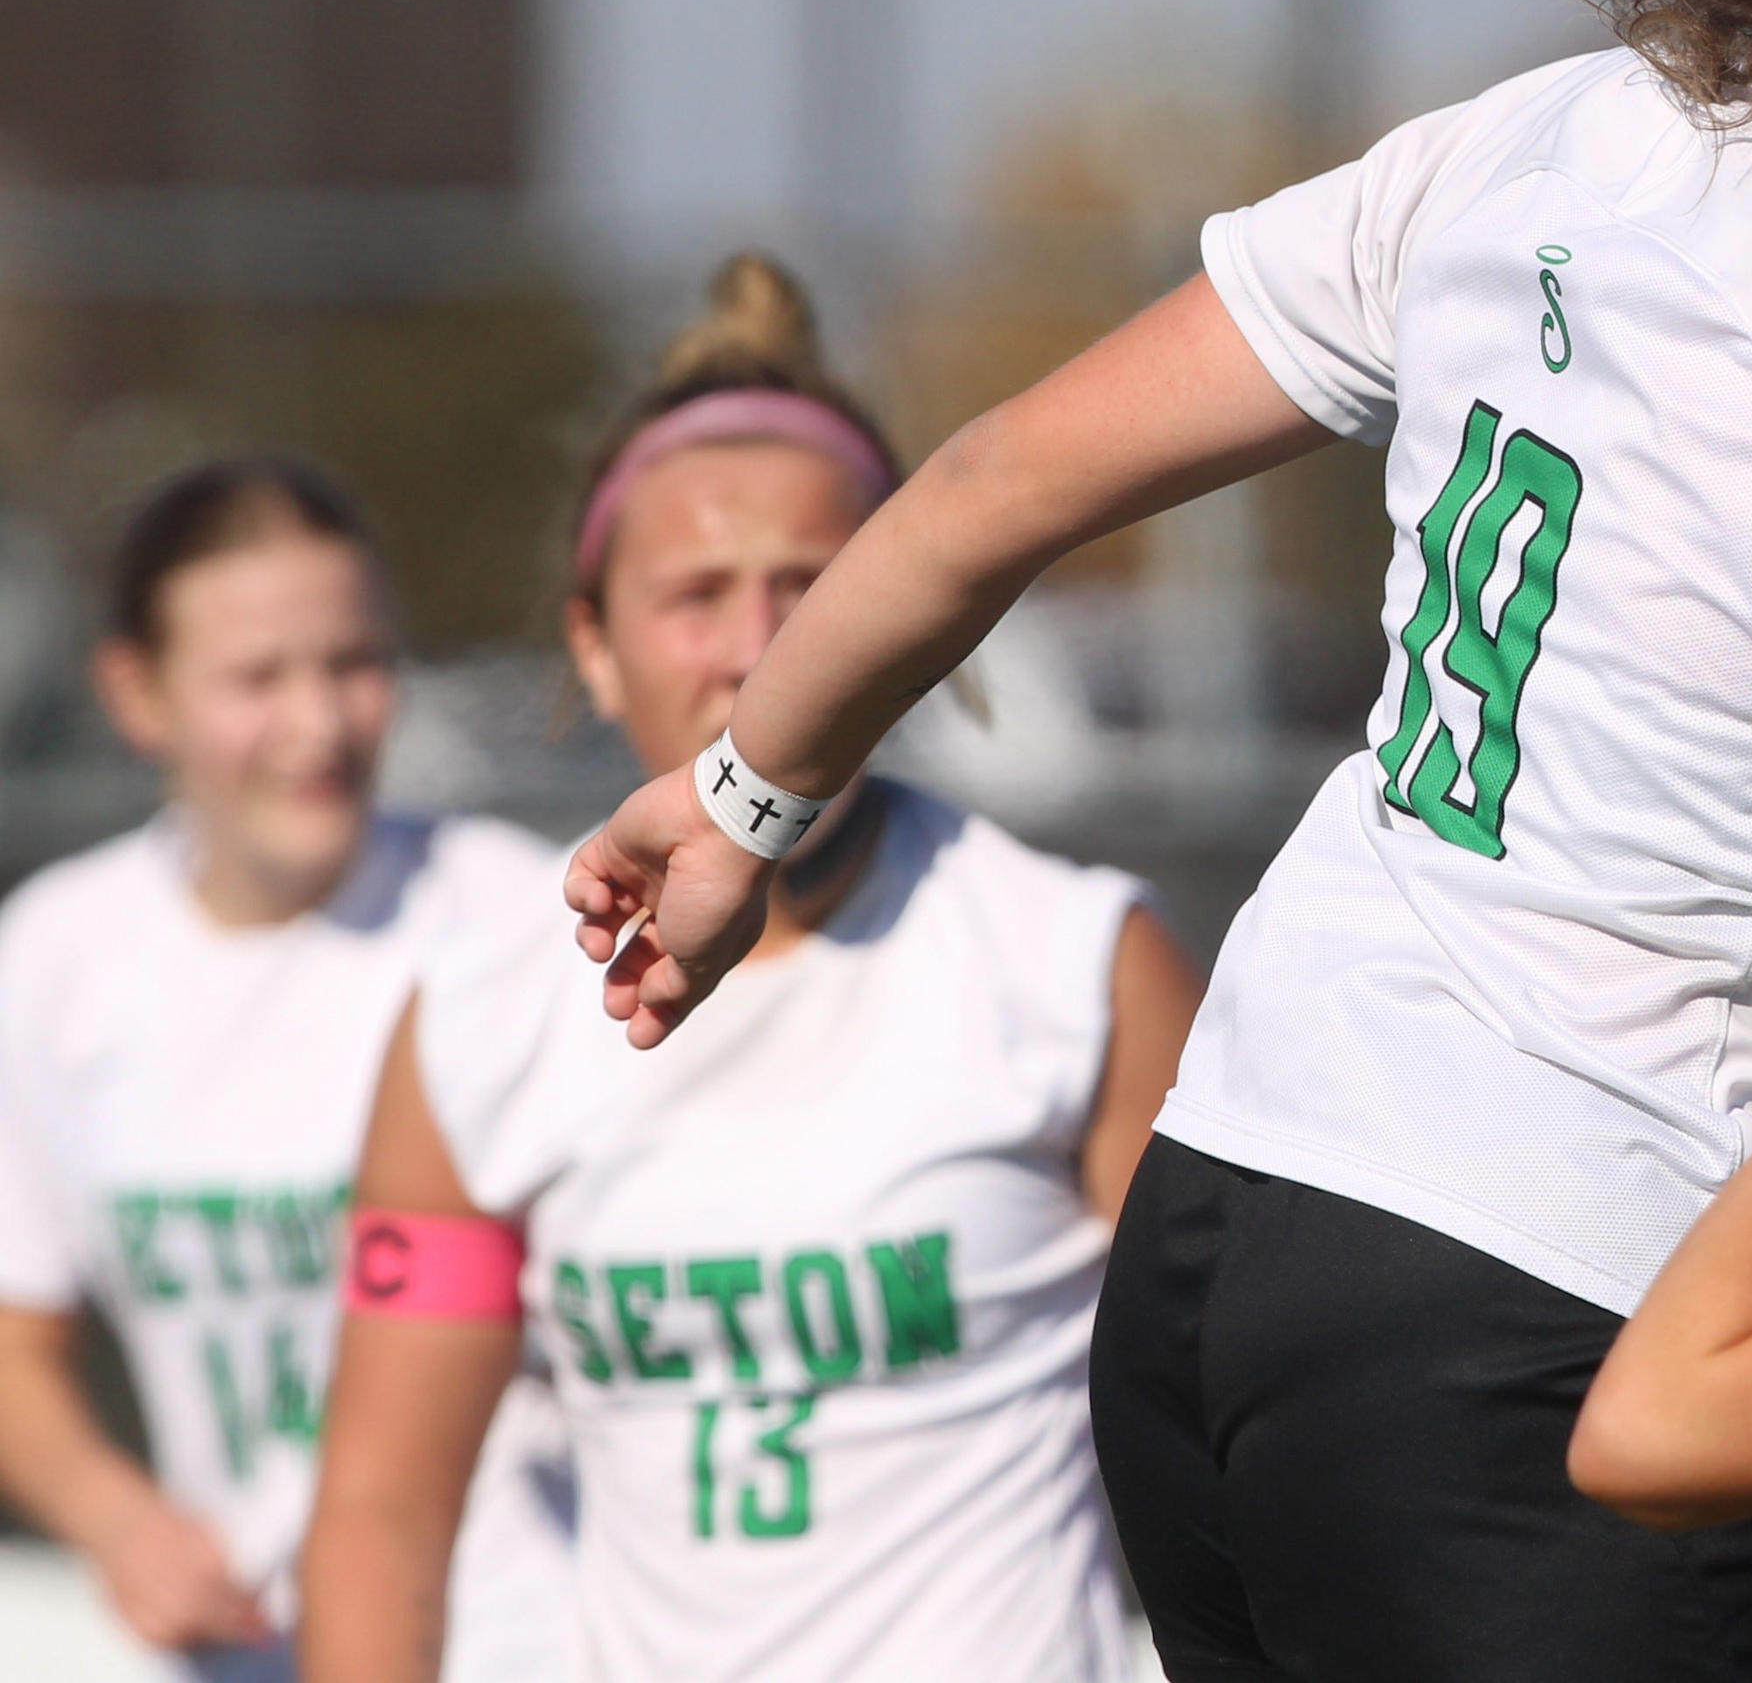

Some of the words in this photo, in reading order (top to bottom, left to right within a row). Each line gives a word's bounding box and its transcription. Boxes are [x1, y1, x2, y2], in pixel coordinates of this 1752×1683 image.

[1377, 397, 1583, 862] 19
[354, 1225, 411, 1301] C
[550, 1230, 961, 1386] SETON
[688, 1392, 814, 1540] 13
